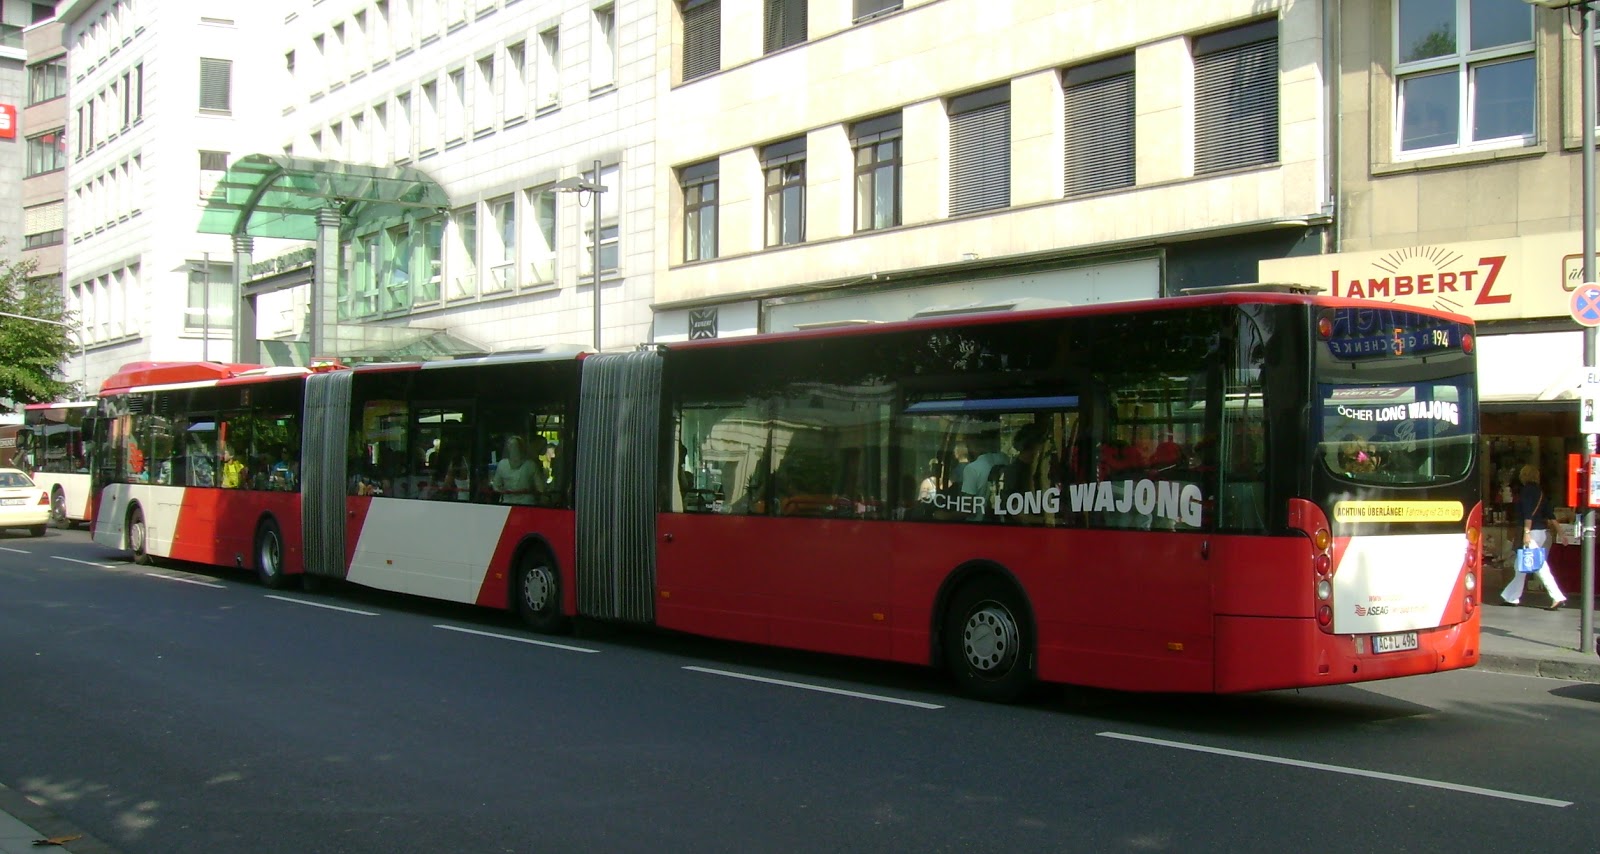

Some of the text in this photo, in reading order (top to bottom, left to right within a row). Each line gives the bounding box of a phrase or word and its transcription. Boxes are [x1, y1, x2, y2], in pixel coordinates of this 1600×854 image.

[1331, 255, 1513, 305] LAMBERTZ
[1432, 329, 1449, 348] 194
[1587, 372, 1600, 384] EL
[1338, 400, 1459, 426] ÖCHER LONG WAJONG
[994, 491, 1060, 515] LONG
[1070, 478, 1202, 527] WAJONG
[1337, 507, 1366, 517] ACHTUNG
[1367, 506, 1404, 517] ÜBERLÄNGE!
[1366, 606, 1389, 616] ASEAG
[1379, 633, 1416, 650] AC L 496
